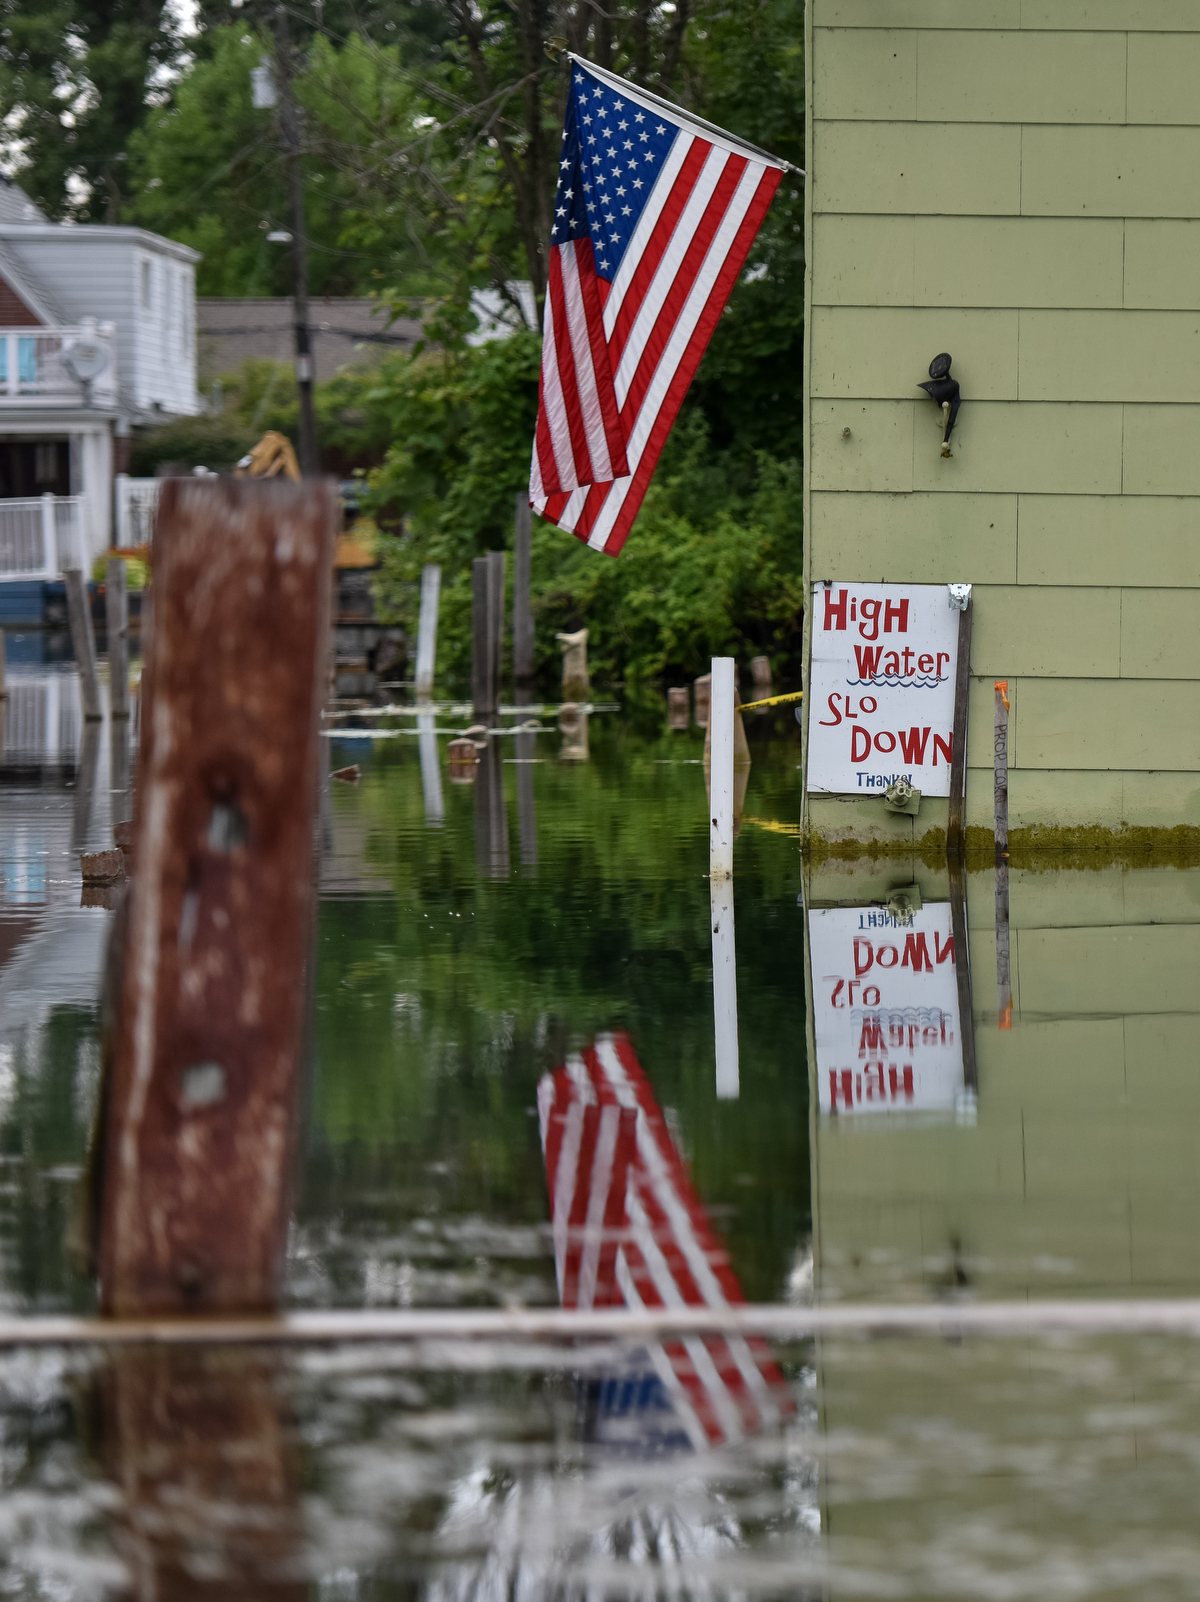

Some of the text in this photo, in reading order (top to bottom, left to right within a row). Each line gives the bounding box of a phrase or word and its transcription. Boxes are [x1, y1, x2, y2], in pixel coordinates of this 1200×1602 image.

[853, 644, 950, 682] Water
[818, 692, 878, 726] SLO
[851, 725, 953, 766] DOWN
